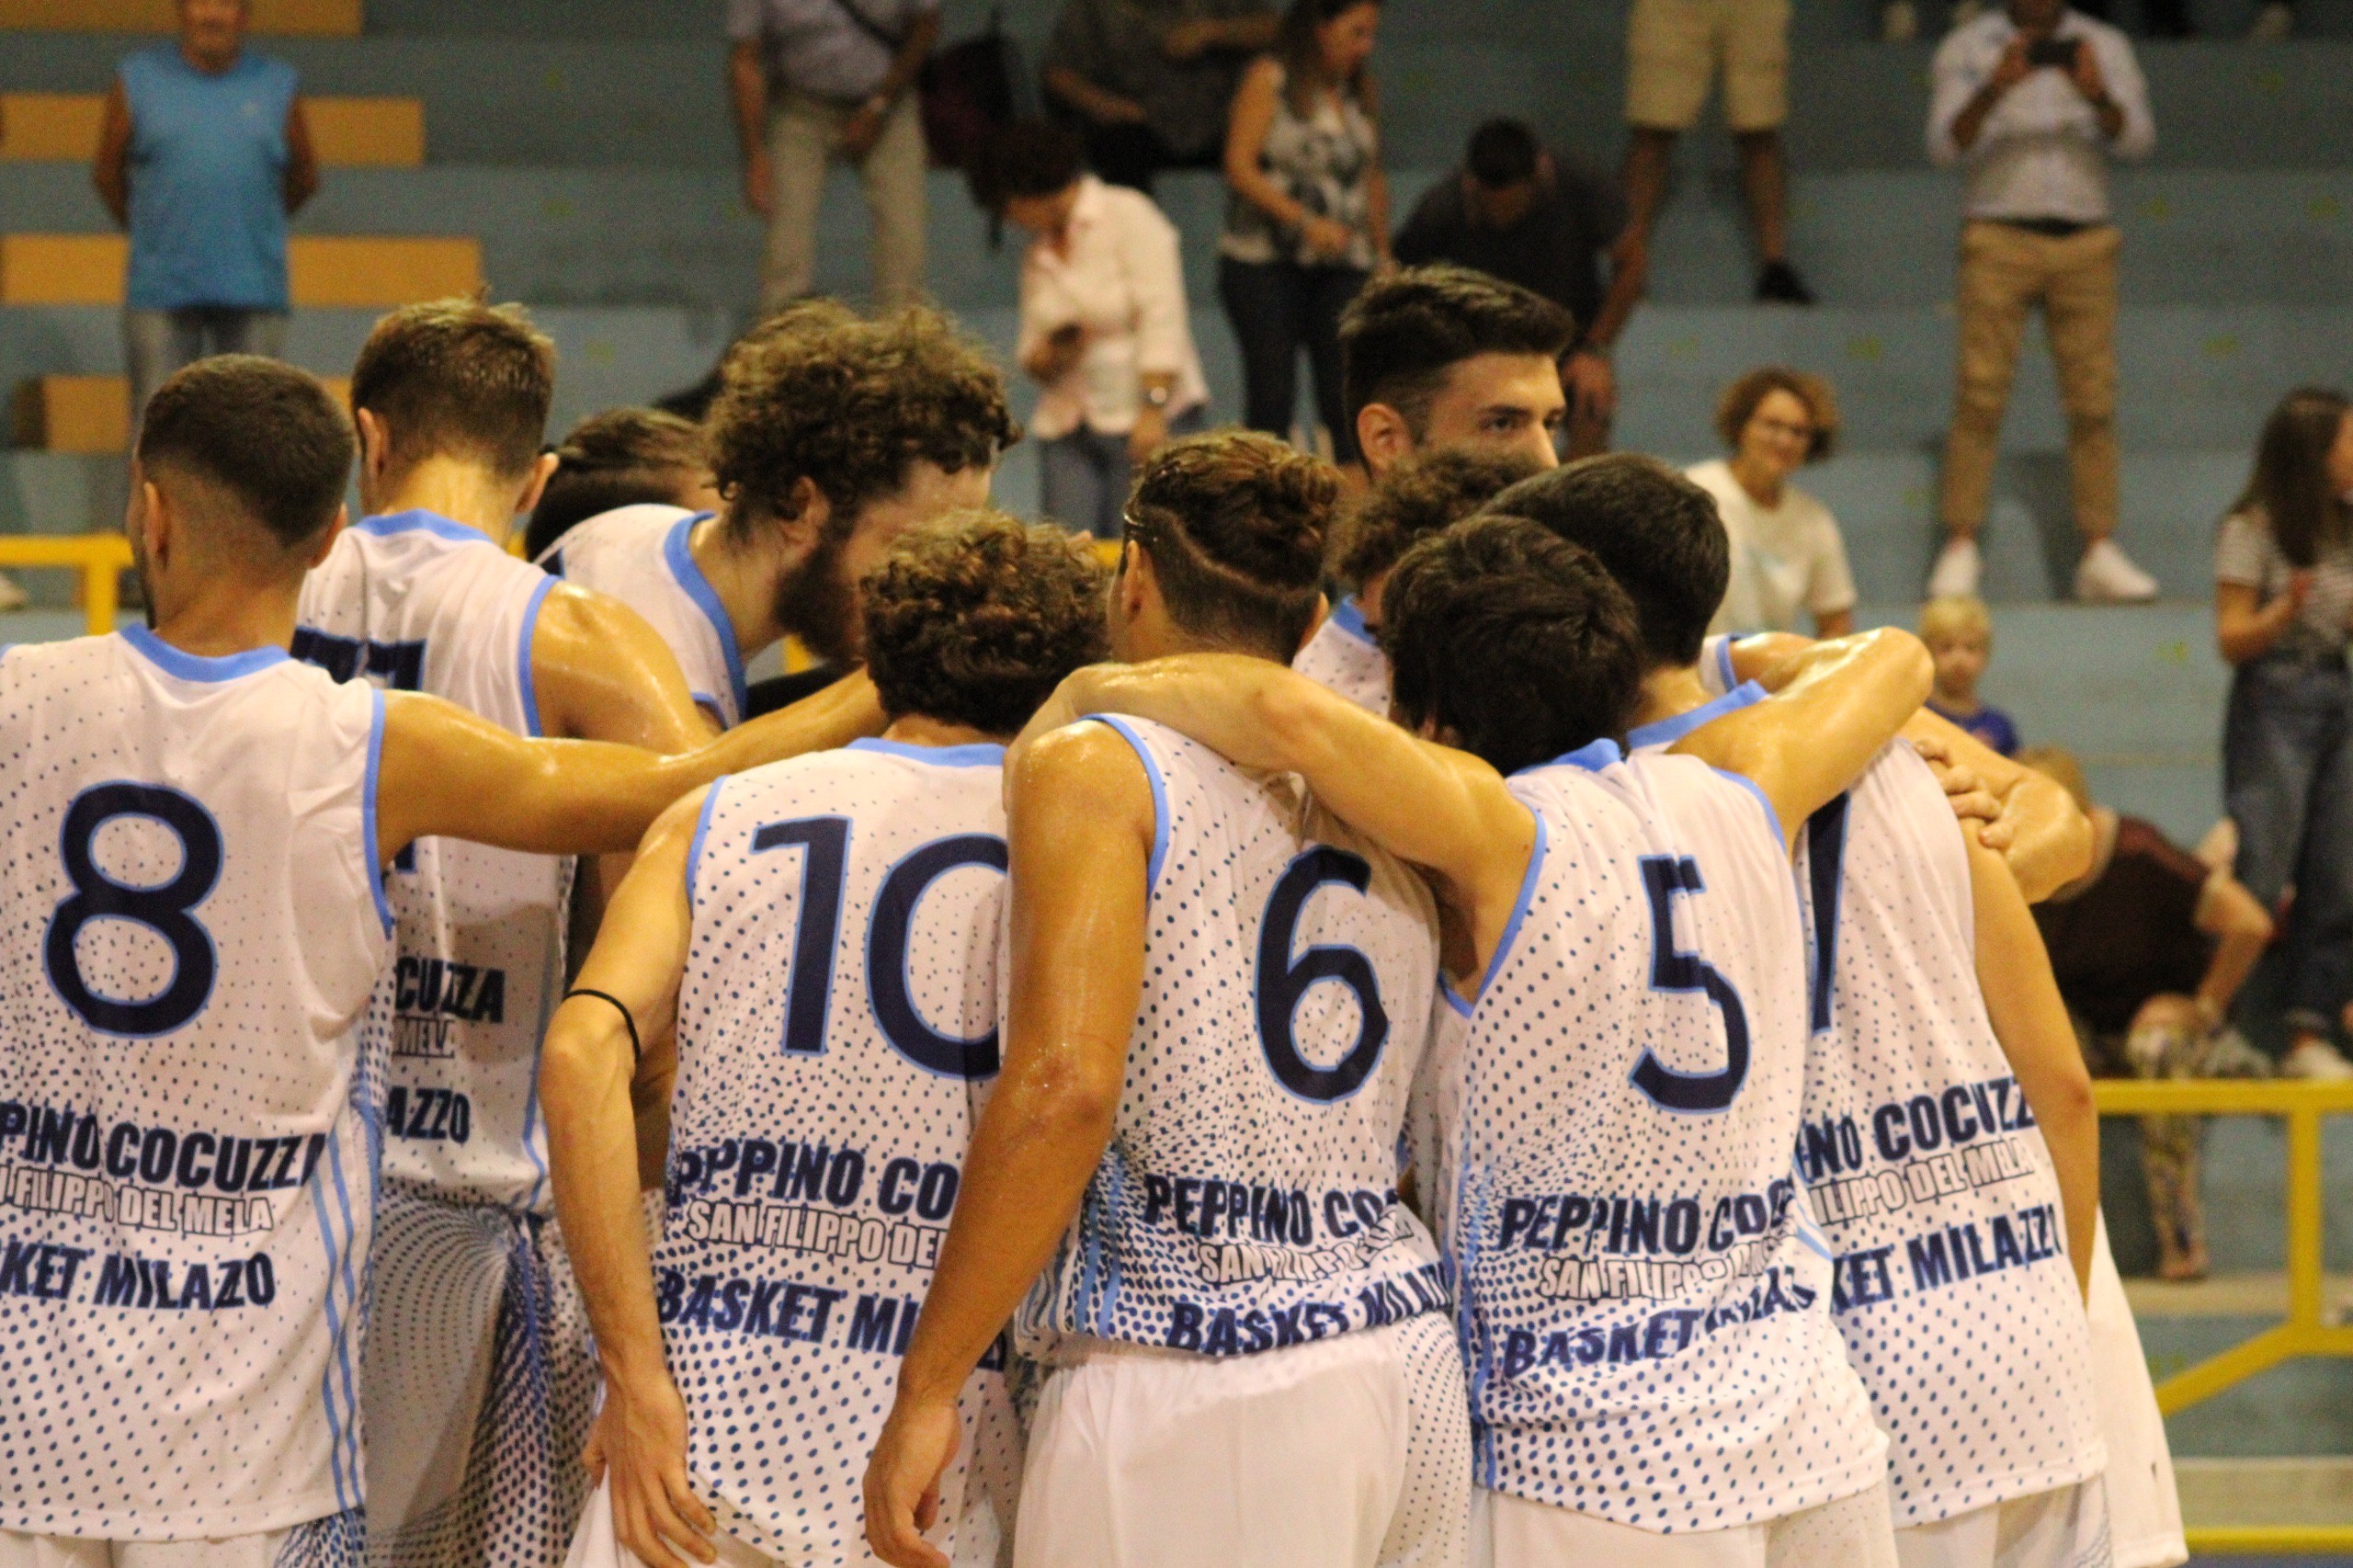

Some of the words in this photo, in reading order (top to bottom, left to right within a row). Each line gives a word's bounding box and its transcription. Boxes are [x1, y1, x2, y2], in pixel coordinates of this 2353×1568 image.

[43, 779, 224, 1039] 8
[750, 814, 1008, 1081] 10
[1254, 844, 1390, 1104] 6
[1631, 854, 1749, 1114] 5
[118, 1184, 178, 1232] DEL
[180, 1193, 274, 1237] MELA
[1142, 1173, 1313, 1248] PEPPINO
[1905, 1153, 1968, 1204] DEL
[688, 1197, 761, 1244] SAN
[762, 1205, 886, 1263] FILIPPO
[1499, 1195, 1700, 1256] PEPPINO
[1198, 1243, 1267, 1286] SAN
[1540, 1257, 1603, 1301] SAN
[1605, 1257, 1728, 1301] FILIPPO
[658, 1270, 843, 1344] BASKET
[1165, 1298, 1350, 1358] BASKET
[1504, 1308, 1705, 1380] BASKET
